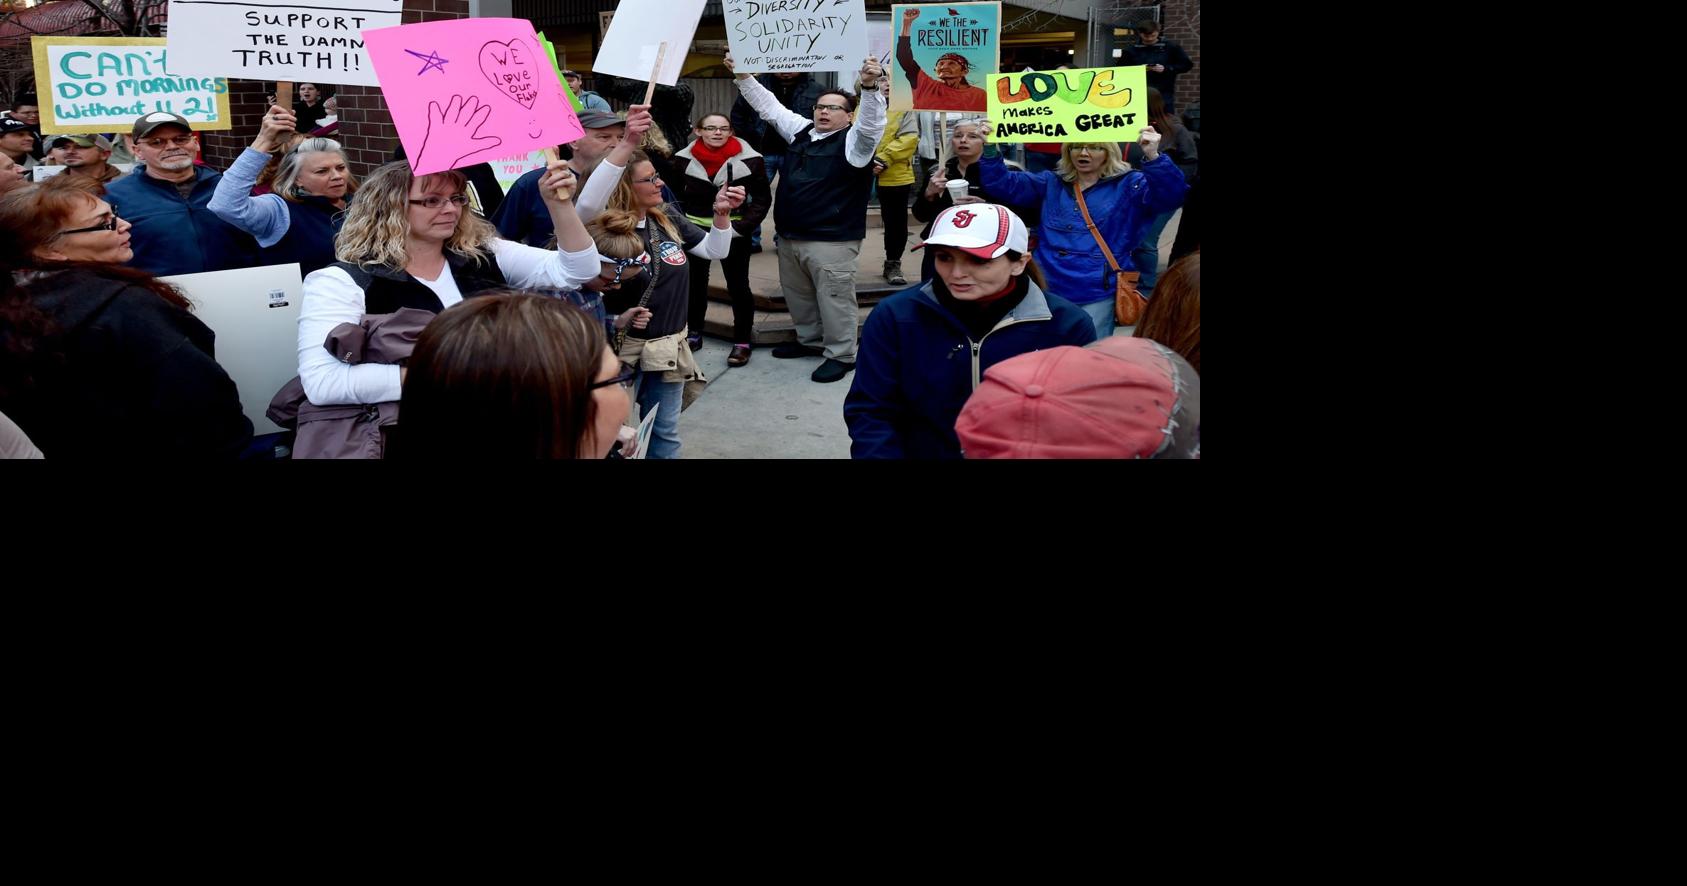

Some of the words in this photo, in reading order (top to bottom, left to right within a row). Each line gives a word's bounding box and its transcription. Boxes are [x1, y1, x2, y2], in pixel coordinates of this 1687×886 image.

[746, 0, 825, 20] DIVERSITY
[245, 11, 366, 30] SUPPORT
[734, 14, 852, 42] SOLIDARITY
[939, 17, 950, 28] WE
[953, 17, 967, 27] THE
[246, 34, 289, 46] THE
[302, 35, 365, 49] DAMN
[757, 32, 821, 54] UNITY
[917, 28, 990, 47] RESILIENT
[490, 48, 525, 66] WE
[743, 57, 762, 65] NOT
[765, 54, 828, 64] DISCRIMINATION
[56, 82, 108, 100] DO
[996, 69, 1132, 109] LOVE
[1075, 112, 1136, 132] GREAT
[503, 164, 523, 175] YOU
